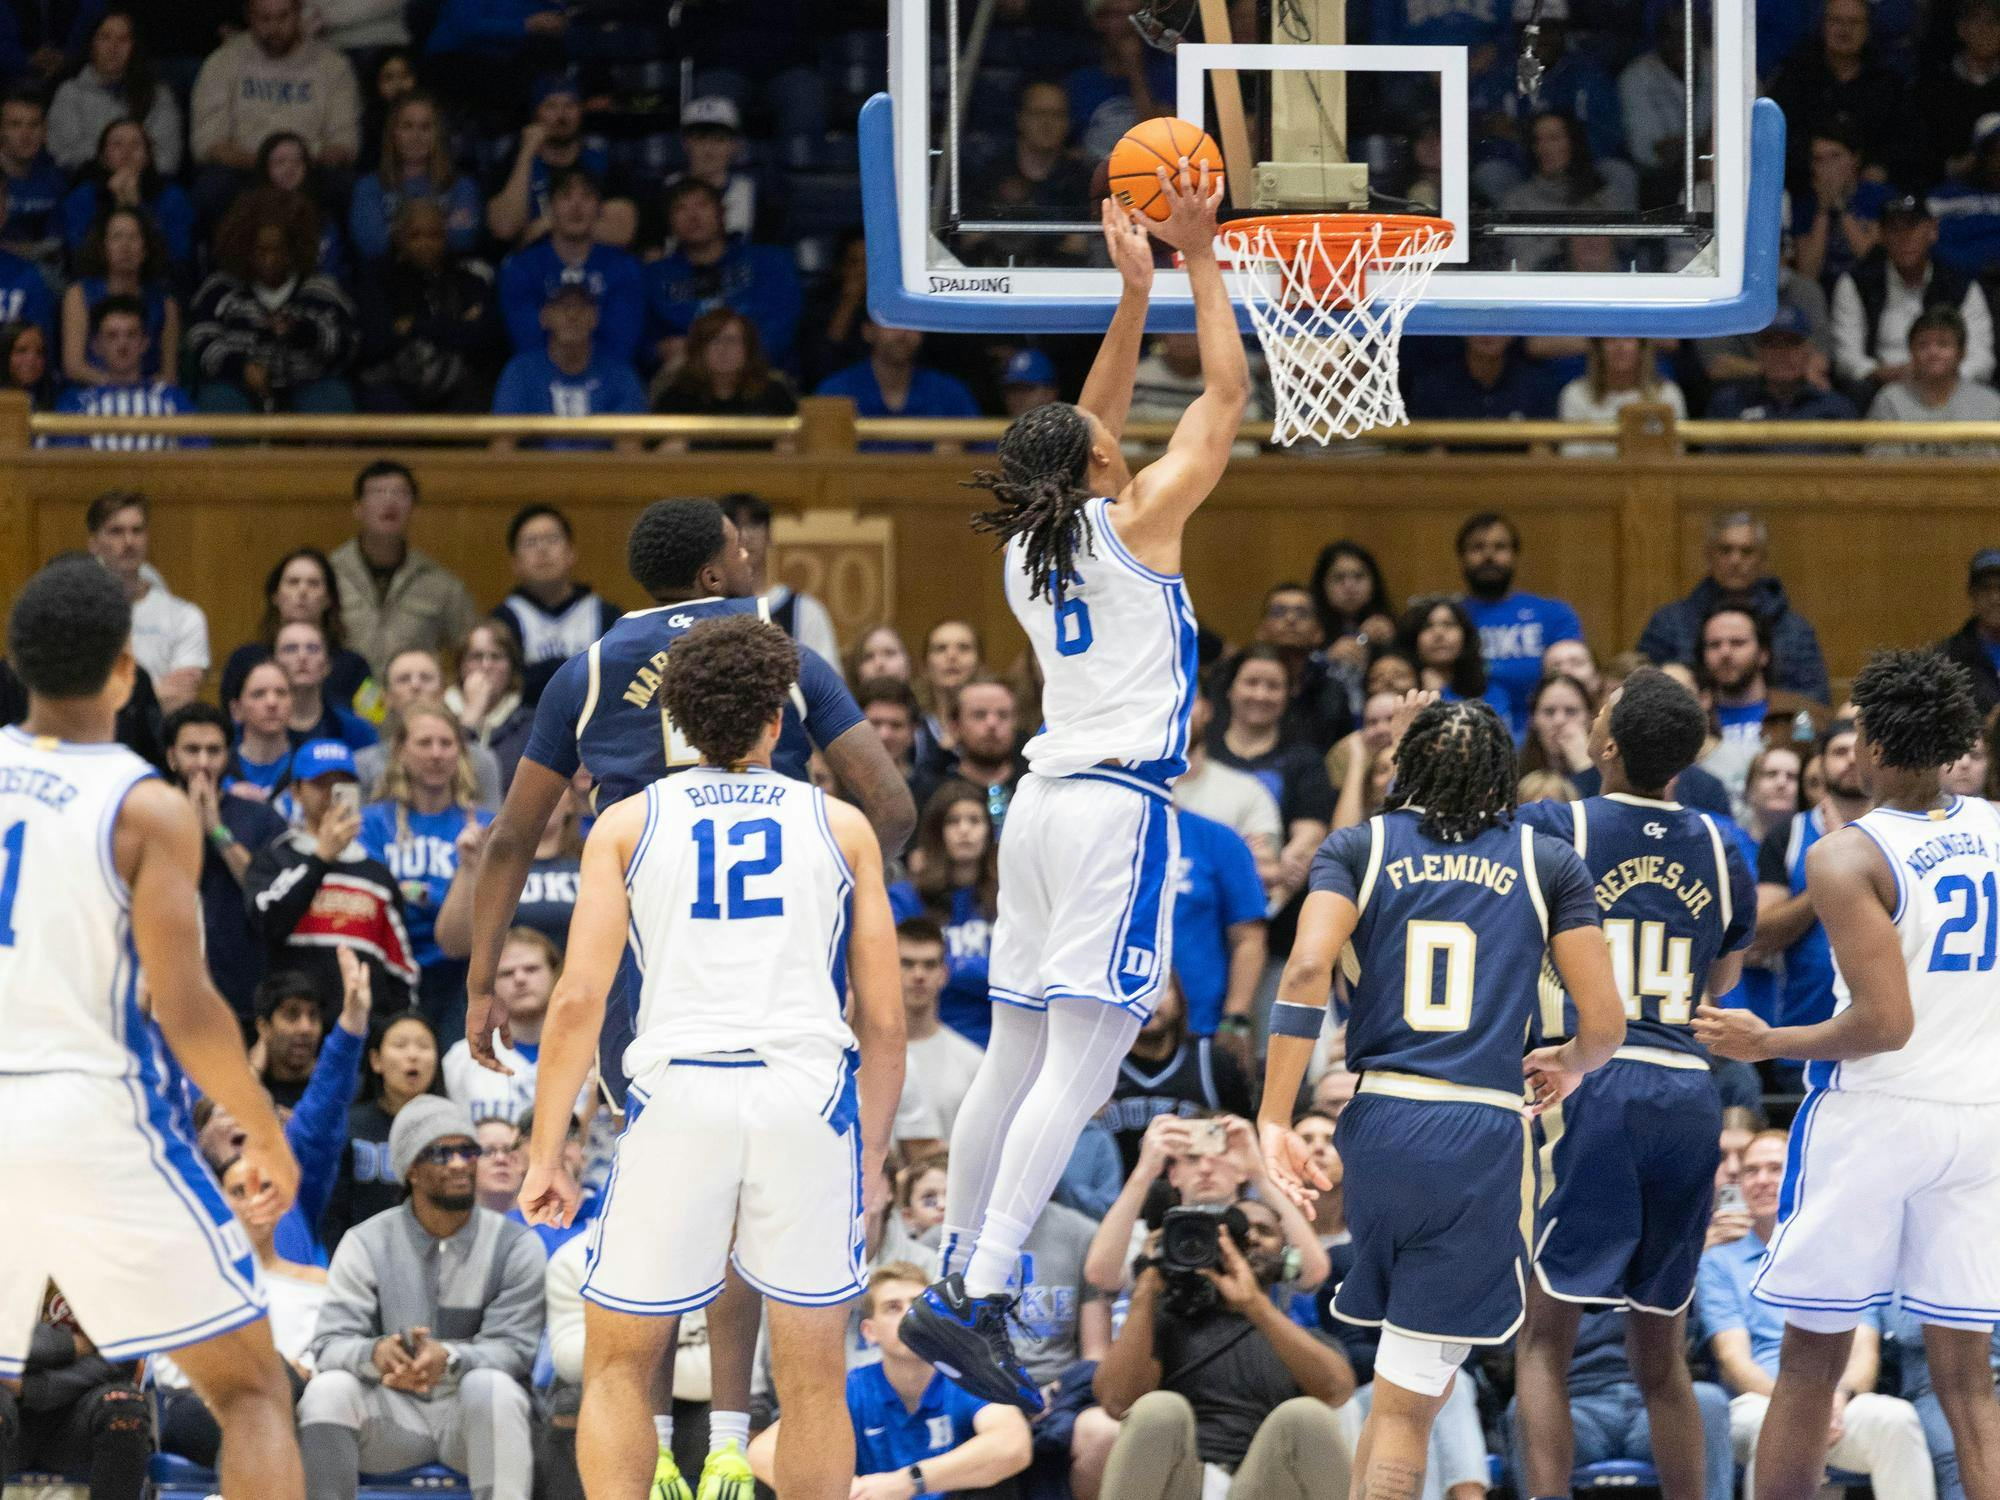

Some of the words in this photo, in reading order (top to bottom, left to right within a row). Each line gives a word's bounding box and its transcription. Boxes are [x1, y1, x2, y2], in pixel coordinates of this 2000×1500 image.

[929, 276, 1011, 294] SPALDING
[623, 651, 670, 710] MAR
[685, 783, 786, 808] BOOZER
[1, 820, 26, 947] 1
[690, 817, 784, 920] 12
[1386, 854, 1518, 896] FLEMING
[1593, 855, 1685, 912] REEVES
[1927, 871, 1999, 972] 21
[1121, 945, 1154, 977] D
[1403, 919, 1477, 1031] 0
[1602, 918, 1695, 1025] 14
